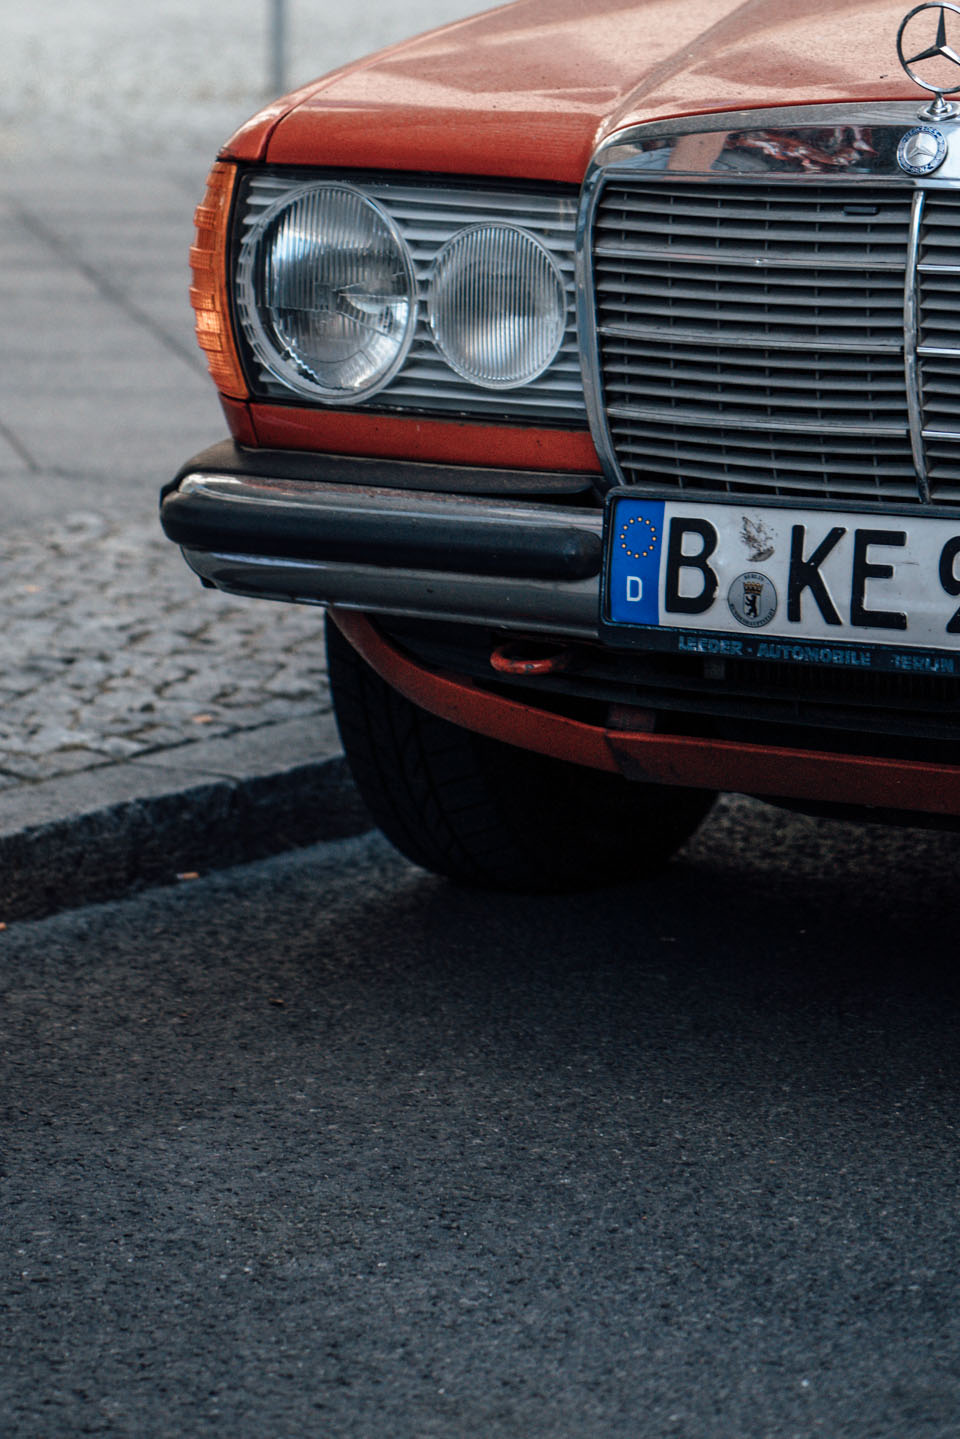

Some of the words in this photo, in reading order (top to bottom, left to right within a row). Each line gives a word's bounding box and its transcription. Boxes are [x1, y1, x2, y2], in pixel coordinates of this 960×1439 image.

[665, 517, 720, 615] B
[787, 524, 909, 631] KE
[626, 575, 643, 602] D
[756, 642, 871, 666] AUTOMOBILE
